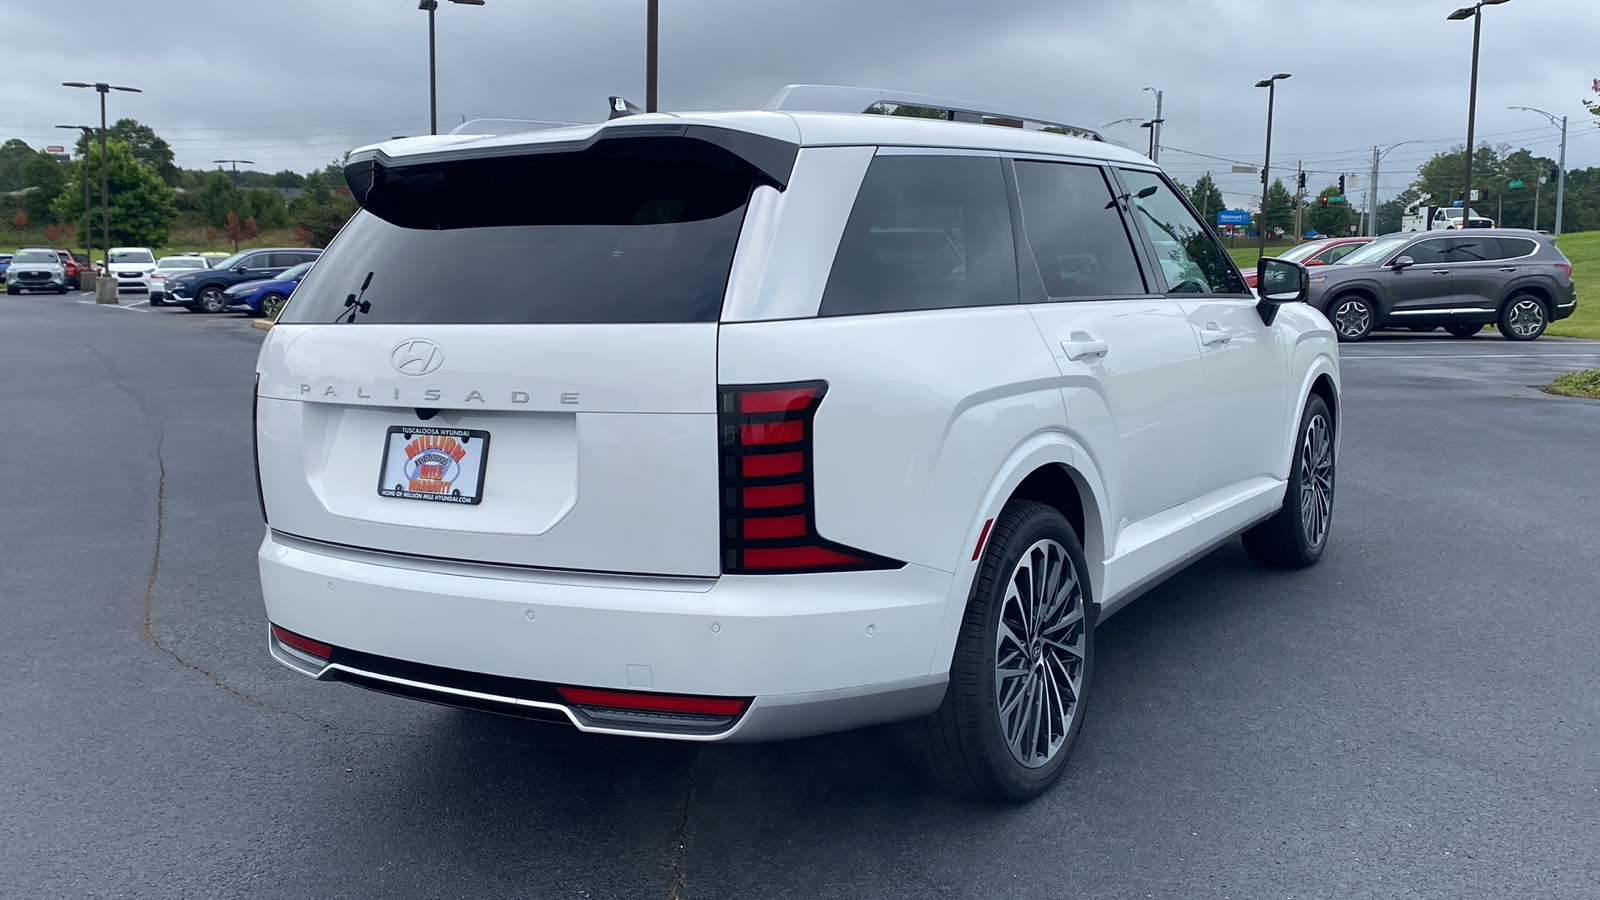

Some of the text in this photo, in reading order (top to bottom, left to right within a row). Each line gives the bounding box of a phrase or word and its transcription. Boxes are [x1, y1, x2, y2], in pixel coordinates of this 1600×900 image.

[300, 384, 580, 404] PALISADE
[405, 435, 466, 463] MILLION
[420, 464, 443, 480] MILE
[408, 479, 452, 493] WARRANTY
[434, 495, 471, 503] HYUNDAI.COM
